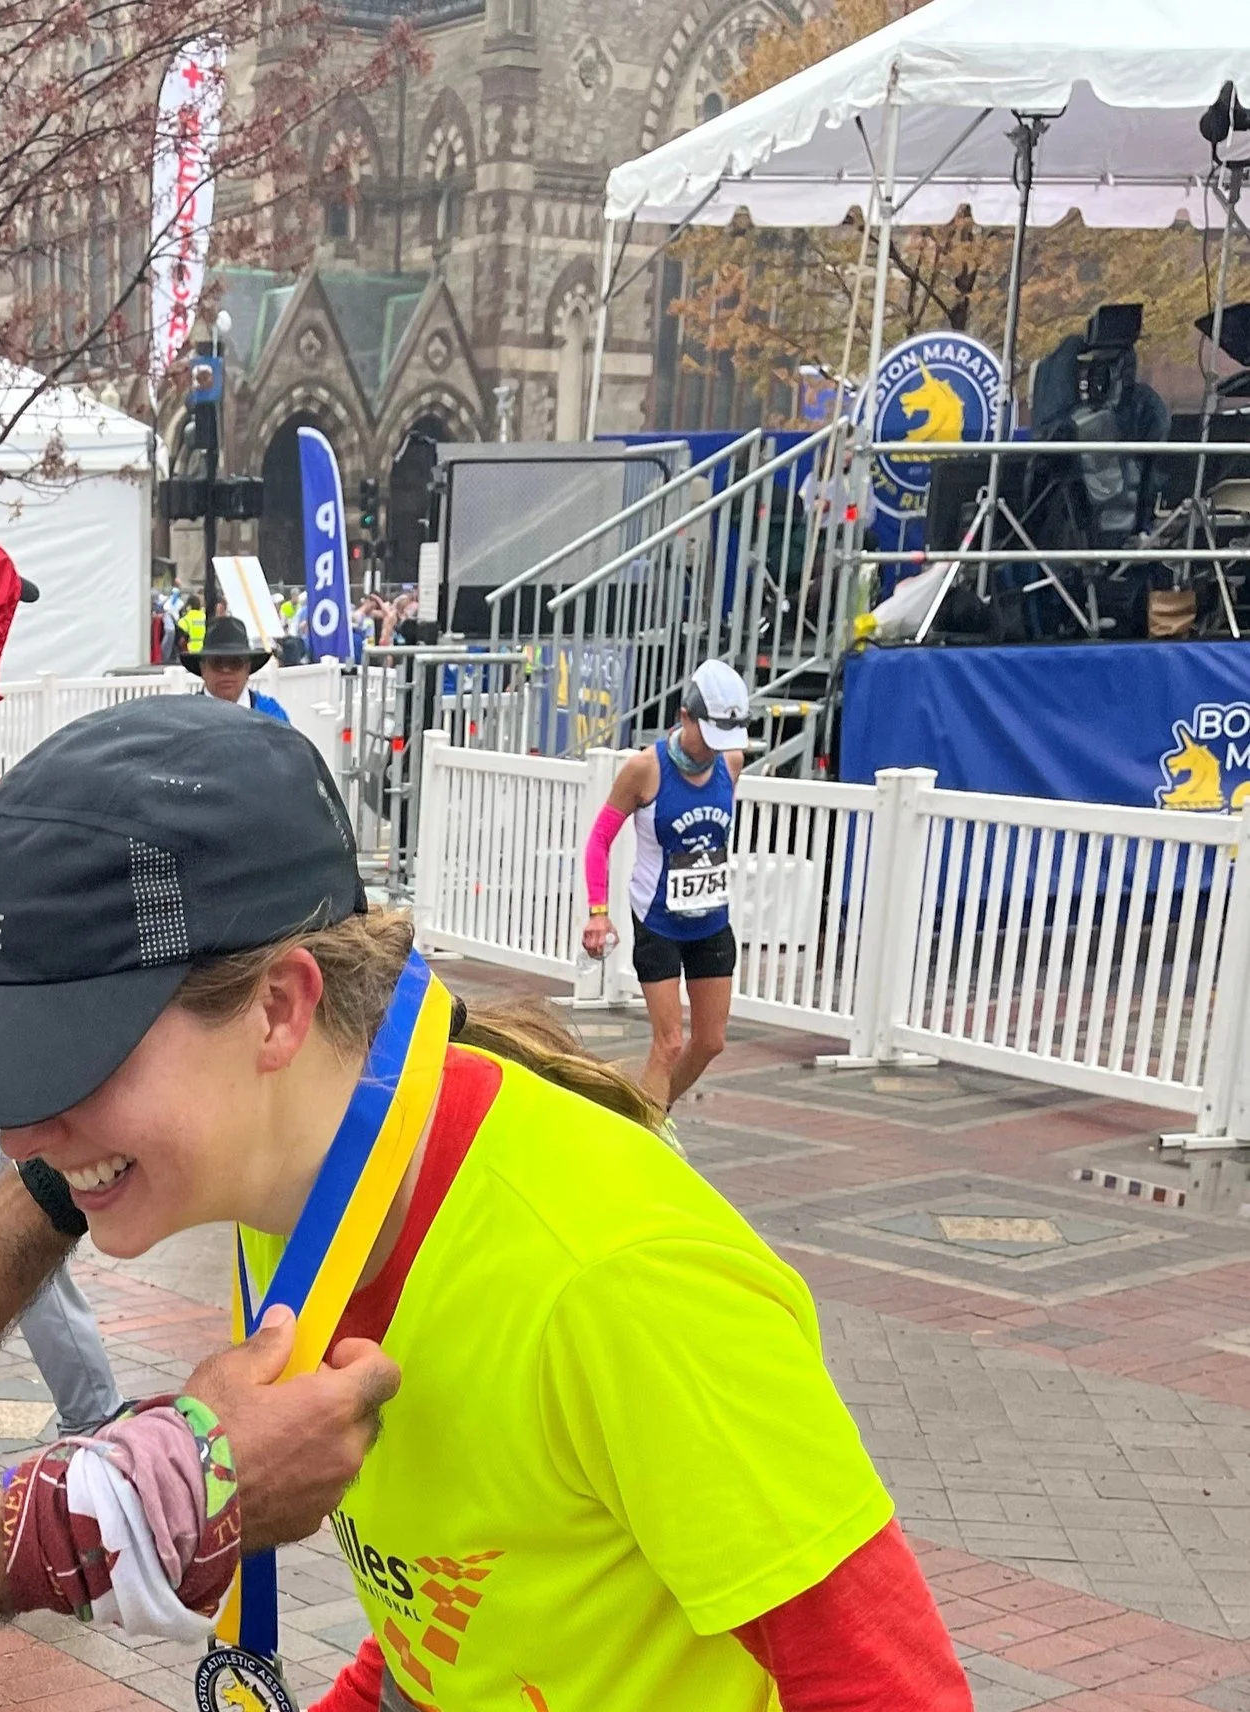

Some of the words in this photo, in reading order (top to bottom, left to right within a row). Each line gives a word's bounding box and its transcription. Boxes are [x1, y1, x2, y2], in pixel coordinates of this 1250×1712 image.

[671, 805, 731, 834] BOSTON
[670, 870, 727, 898] 15754
[206, 1653, 256, 1671] ATHLETIC
